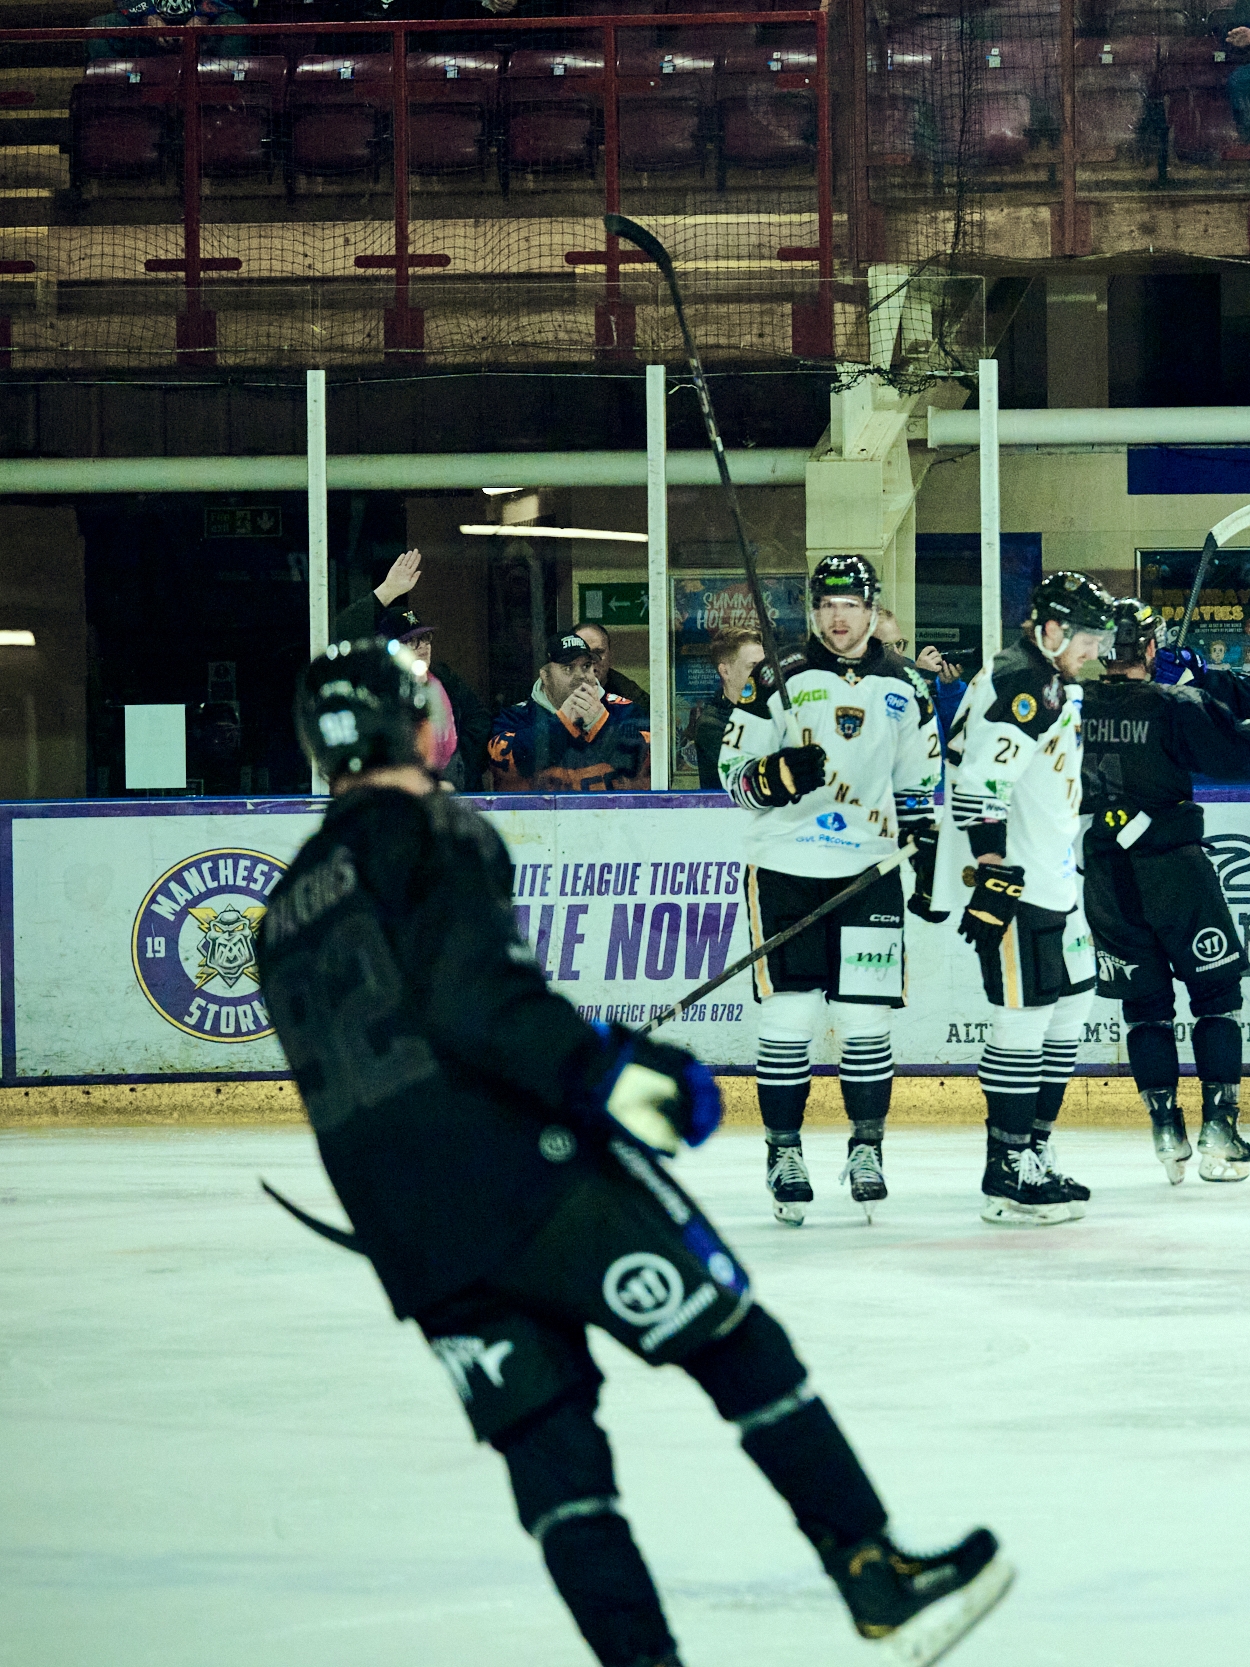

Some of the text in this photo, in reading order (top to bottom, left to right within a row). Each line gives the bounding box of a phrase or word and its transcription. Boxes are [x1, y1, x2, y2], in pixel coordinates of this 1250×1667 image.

[696, 609, 780, 630] HOLIDAS
[994, 737, 1020, 765] 21
[559, 862, 642, 897] LEAGUE
[650, 861, 741, 896] TICKETS
[869, 913, 901, 924] CCM
[145, 936, 166, 959] 19
[604, 902, 739, 981] NOW
[605, 1004, 646, 1023] OFFICE
[681, 1004, 706, 1022] 926
[710, 1003, 744, 1022] 8782
